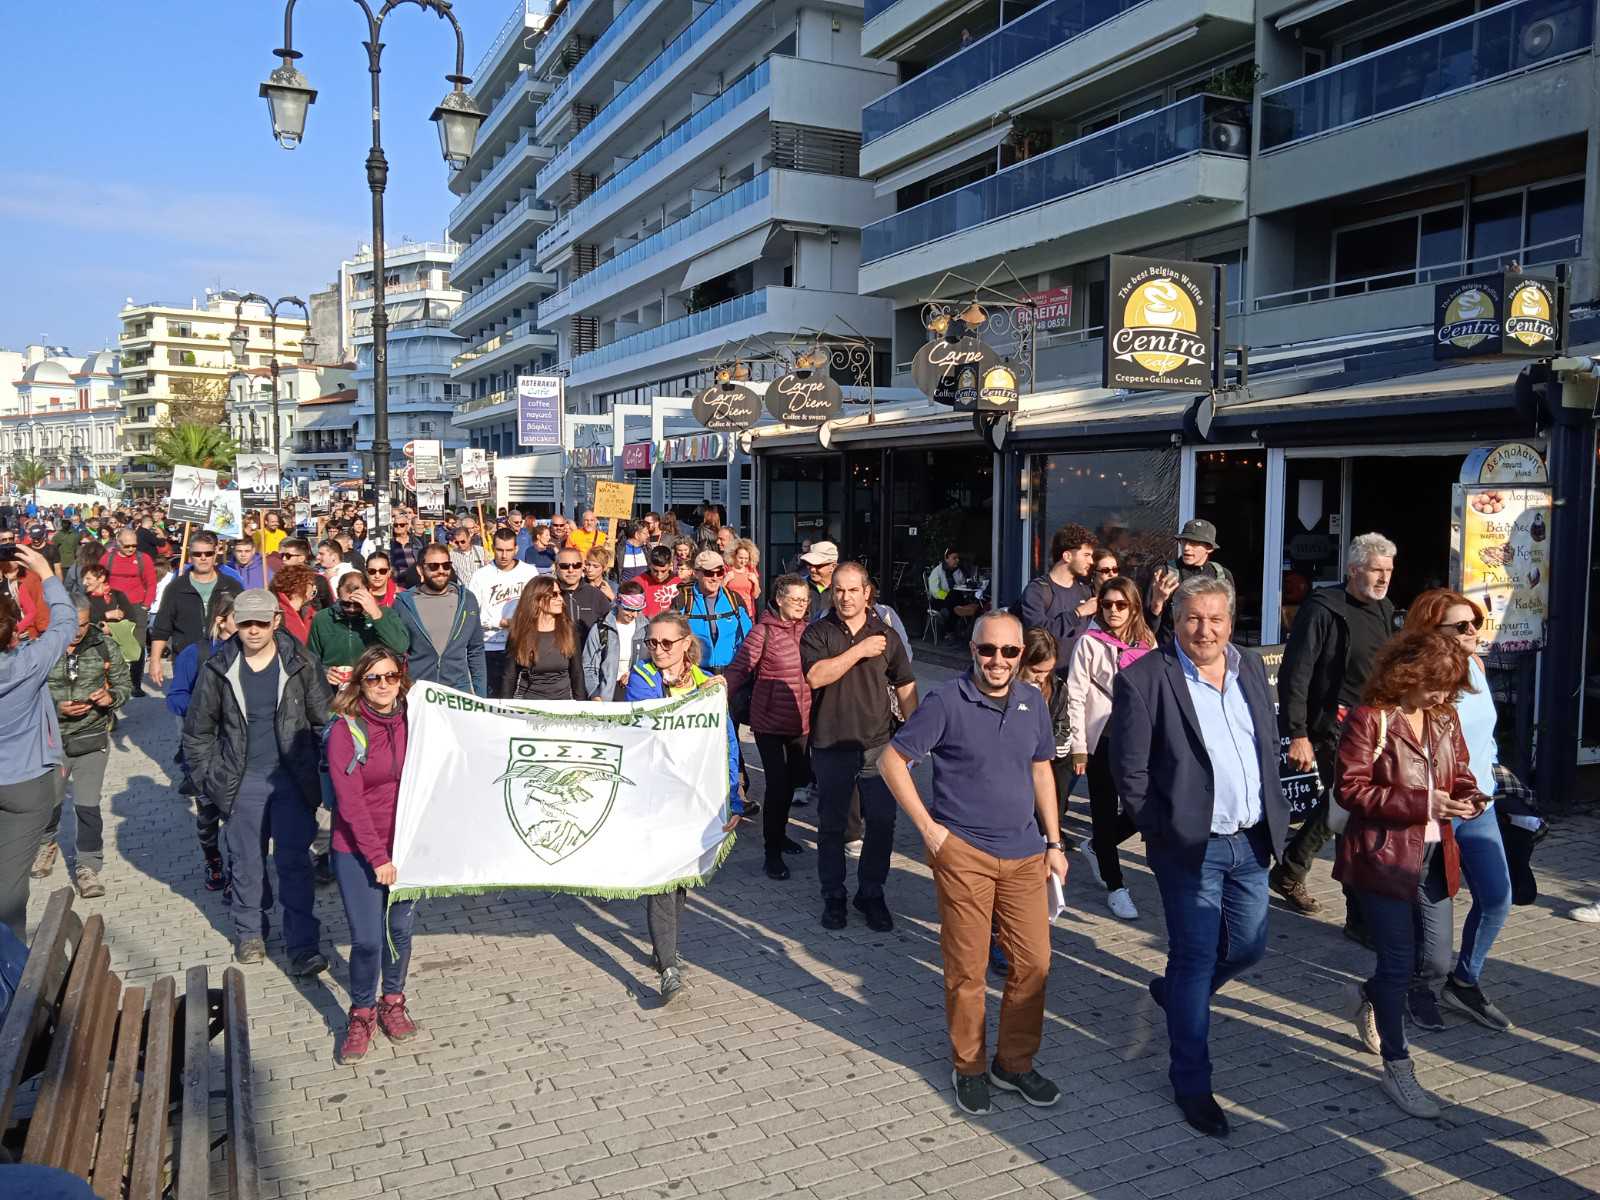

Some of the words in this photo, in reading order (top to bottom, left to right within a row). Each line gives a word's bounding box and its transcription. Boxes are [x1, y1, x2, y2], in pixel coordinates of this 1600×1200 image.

[1118, 284, 1132, 299] The
[1131, 270, 1148, 283] best
[1150, 266, 1180, 279] Belgian
[1181, 273, 1204, 306] Waffles
[1438, 320, 1500, 341] Centro
[1506, 318, 1554, 336] Centro
[1112, 328, 1205, 357] Centro
[928, 340, 984, 366] Carpe
[778, 374, 825, 399] Carpe
[1115, 373, 1144, 383] Crepes
[703, 387, 746, 407] Carpe
[786, 390, 832, 412] Diem
[980, 386, 1018, 399] Centro
[528, 400, 551, 408] coffee
[711, 401, 752, 420] Diem
[651, 712, 720, 731] ΣΠΑΤΩΝ
[1281, 781, 1311, 800] offee
